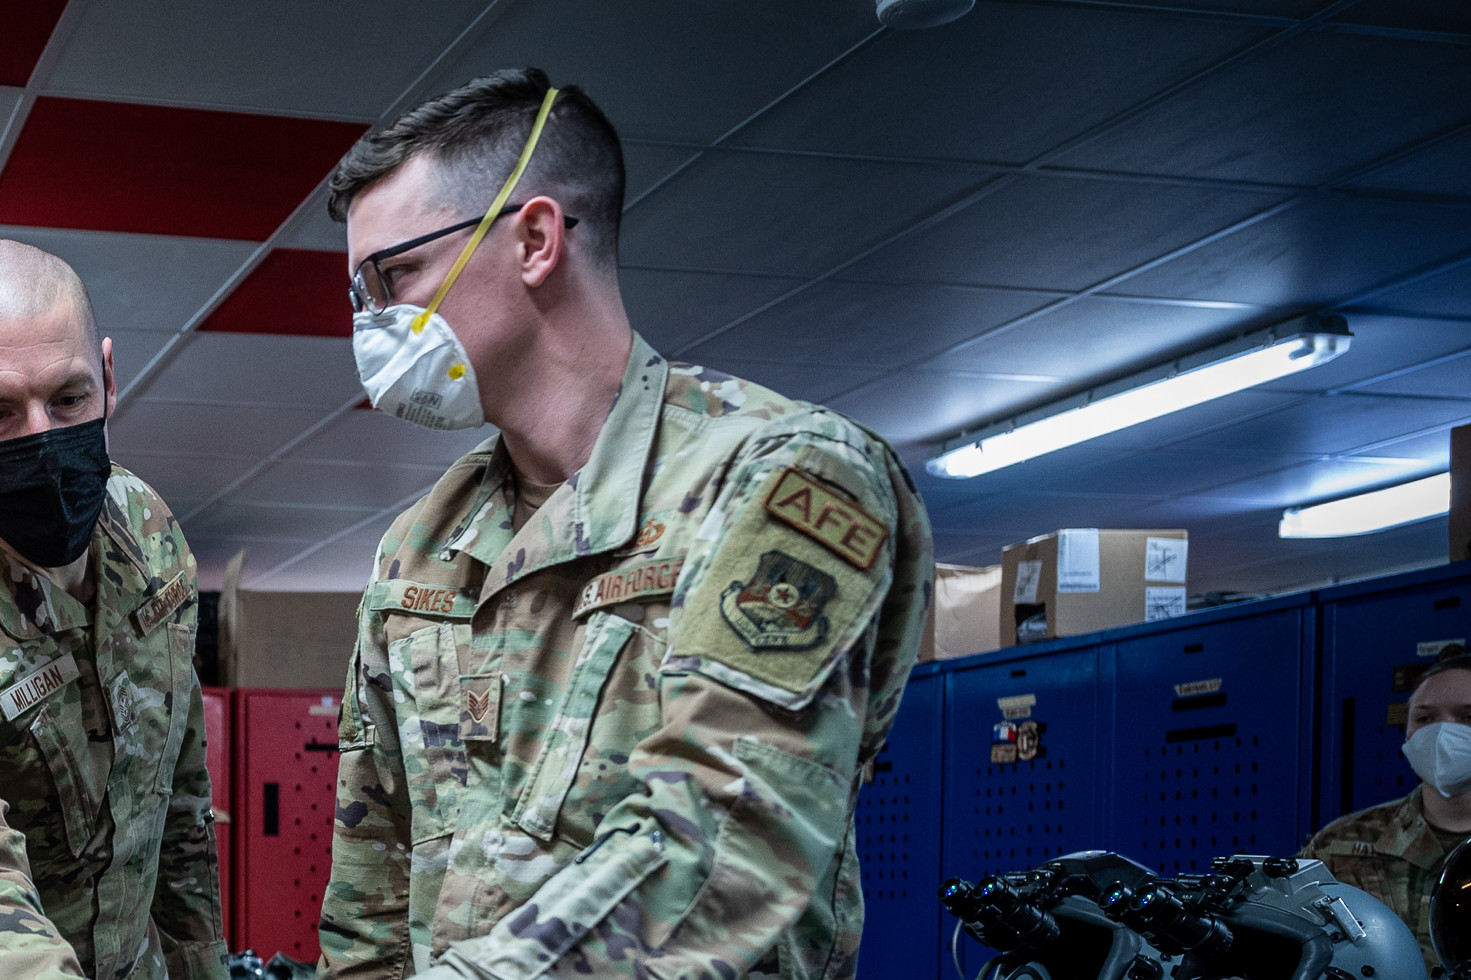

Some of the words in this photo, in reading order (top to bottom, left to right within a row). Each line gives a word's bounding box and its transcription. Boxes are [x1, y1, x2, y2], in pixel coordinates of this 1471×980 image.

[776, 487, 878, 558] AFE
[401, 585, 457, 612] SIKES
[594, 574, 623, 602] AIR
[624, 560, 684, 596] FORCE
[9, 664, 65, 713] MILLIGAN
